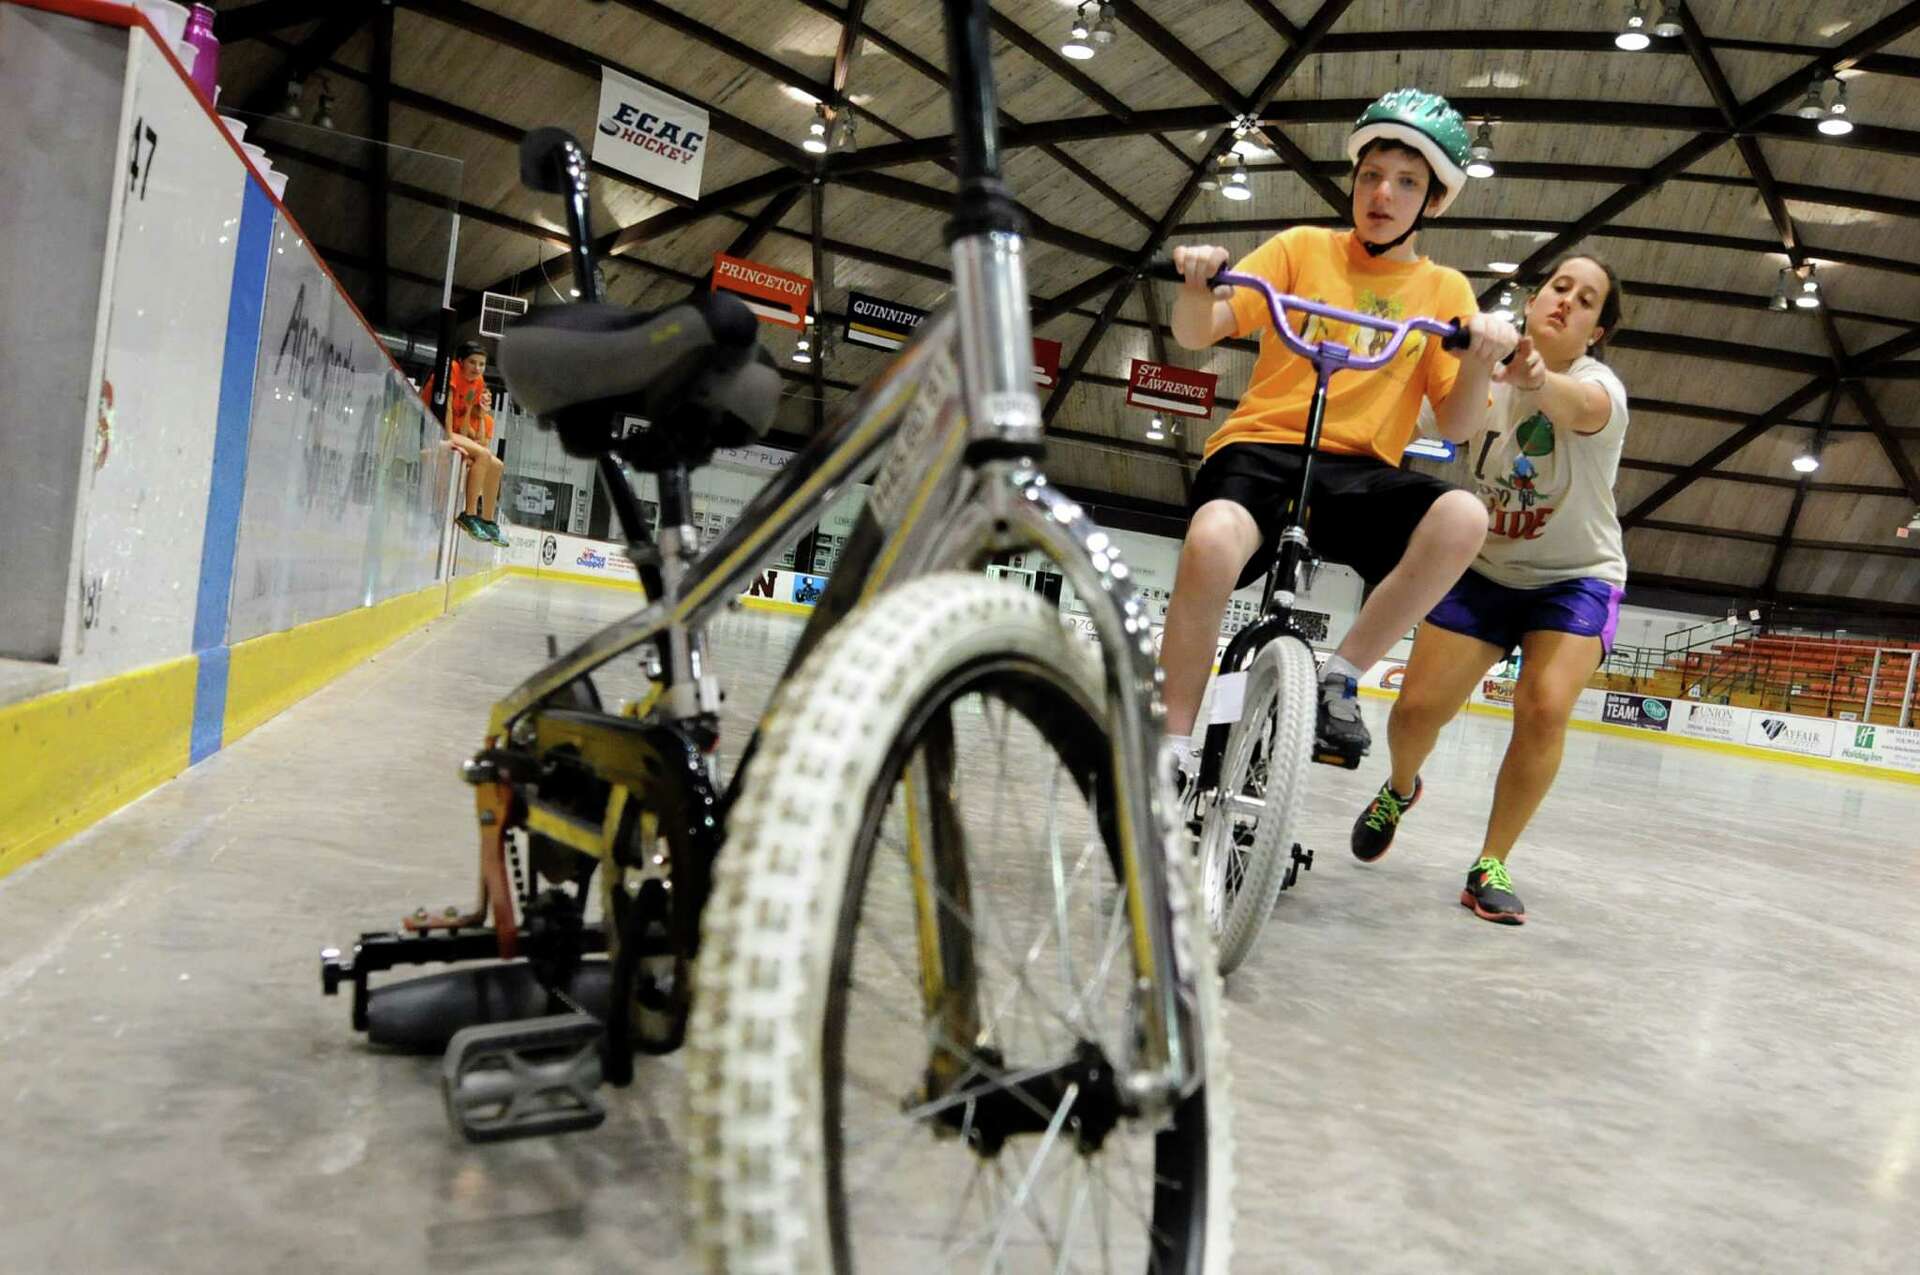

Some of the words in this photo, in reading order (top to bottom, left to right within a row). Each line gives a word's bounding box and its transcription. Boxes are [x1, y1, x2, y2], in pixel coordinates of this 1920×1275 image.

[612, 102, 703, 152] ECAC
[620, 128, 694, 165] HOCKEY
[717, 261, 807, 297] PRINCETON
[853, 300, 926, 328] QUINNIPIA
[1138, 364, 1162, 378] ST.
[1136, 376, 1208, 399] LAWRENCE
[1488, 507, 1554, 540] IDE
[1607, 703, 1639, 721] TEAM!
